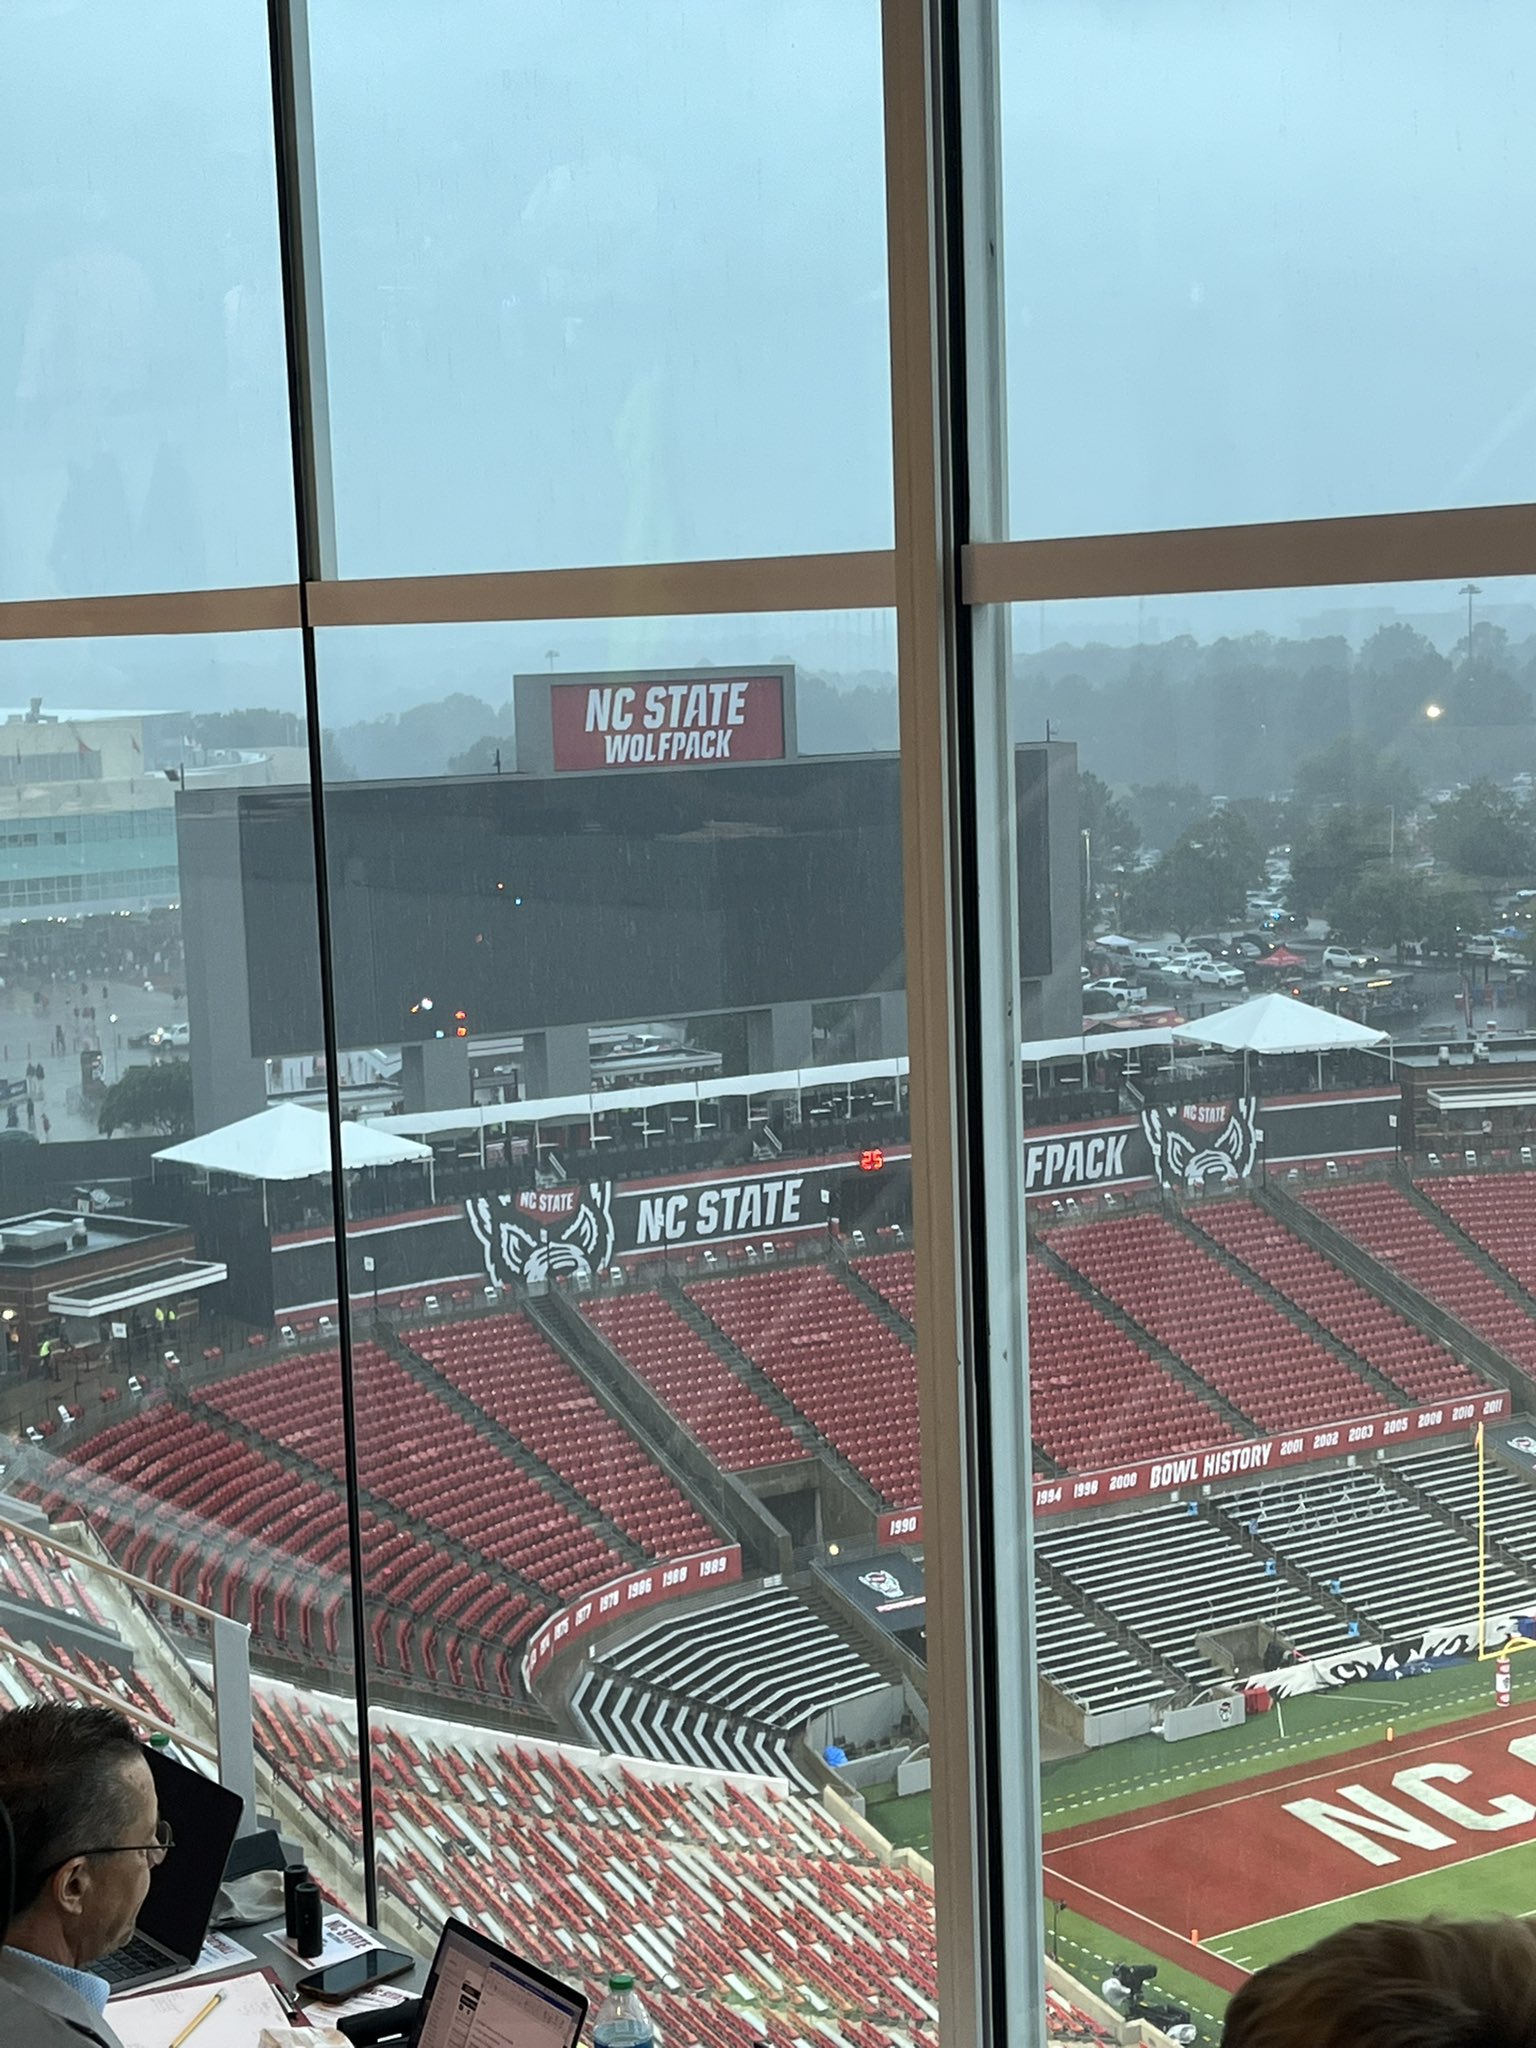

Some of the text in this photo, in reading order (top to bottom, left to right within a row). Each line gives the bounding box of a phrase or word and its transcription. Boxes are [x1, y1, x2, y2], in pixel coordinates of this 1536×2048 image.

[585, 682, 749, 732] NC STATE
[604, 729, 733, 764] WOLFPACK
[1198, 1105, 1226, 1123] STATE
[861, 1149, 883, 1170] 25
[1025, 1134, 1128, 1188] FPACK
[520, 1191, 574, 1213] NC STATE
[636, 1179, 804, 1244] NC STATE
[1036, 1486, 1063, 1506] 1994
[1074, 1479, 1099, 1499] 1998
[1109, 1472, 1138, 1491] 2000
[1150, 1458, 1200, 1489] BOWL
[1202, 1442, 1273, 1478] HISTORY
[1280, 1438, 1304, 1456] 2001
[1313, 1431, 1339, 1450] 2002
[1348, 1424, 1374, 1442] 2003
[1383, 1417, 1409, 1435] 2005
[890, 1516, 917, 1537] 1990
[628, 1577, 653, 1600] 1986
[700, 1556, 727, 1578] 1989
[1281, 1762, 1536, 1866] NC
